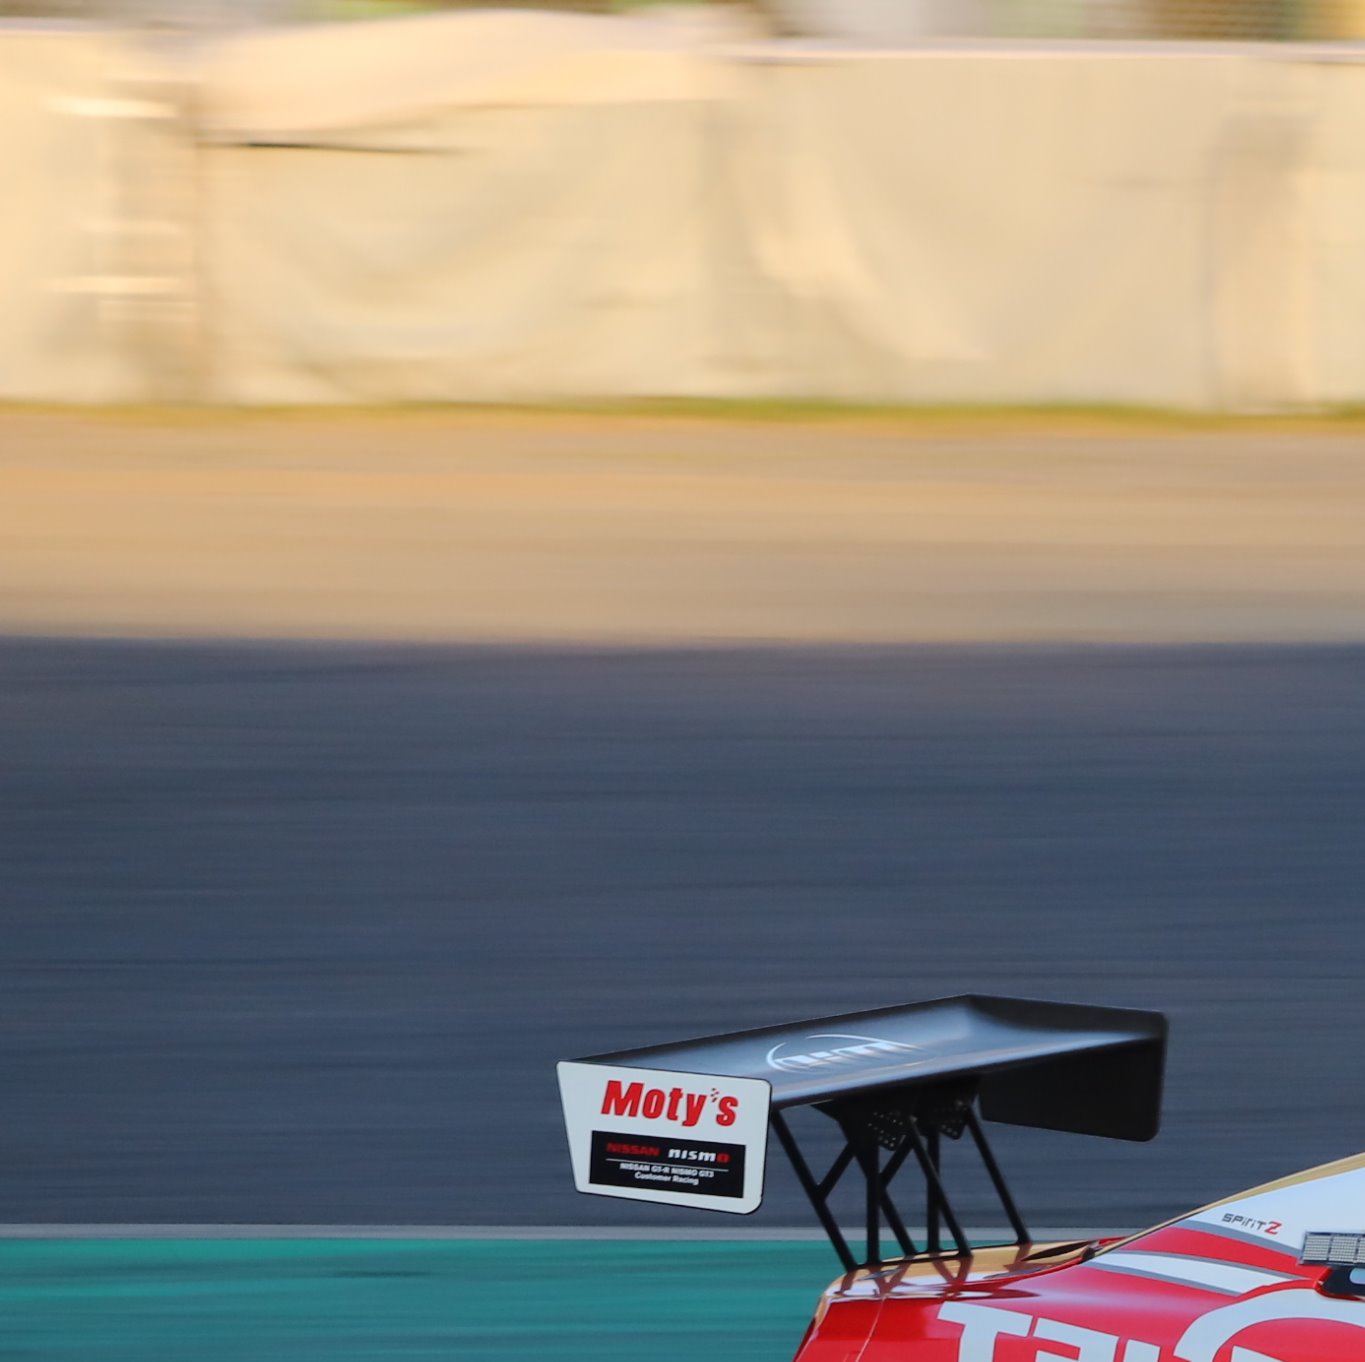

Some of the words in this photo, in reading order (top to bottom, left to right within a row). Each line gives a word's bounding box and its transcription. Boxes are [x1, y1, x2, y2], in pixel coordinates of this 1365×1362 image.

[601, 1080, 738, 1127] Moty's
[607, 1143, 660, 1157] NISSAN
[619, 1162, 650, 1172] NISSAN
[671, 1167, 697, 1177] NISMO
[634, 1171, 671, 1182] Customer
[672, 1175, 699, 1185] Racing
